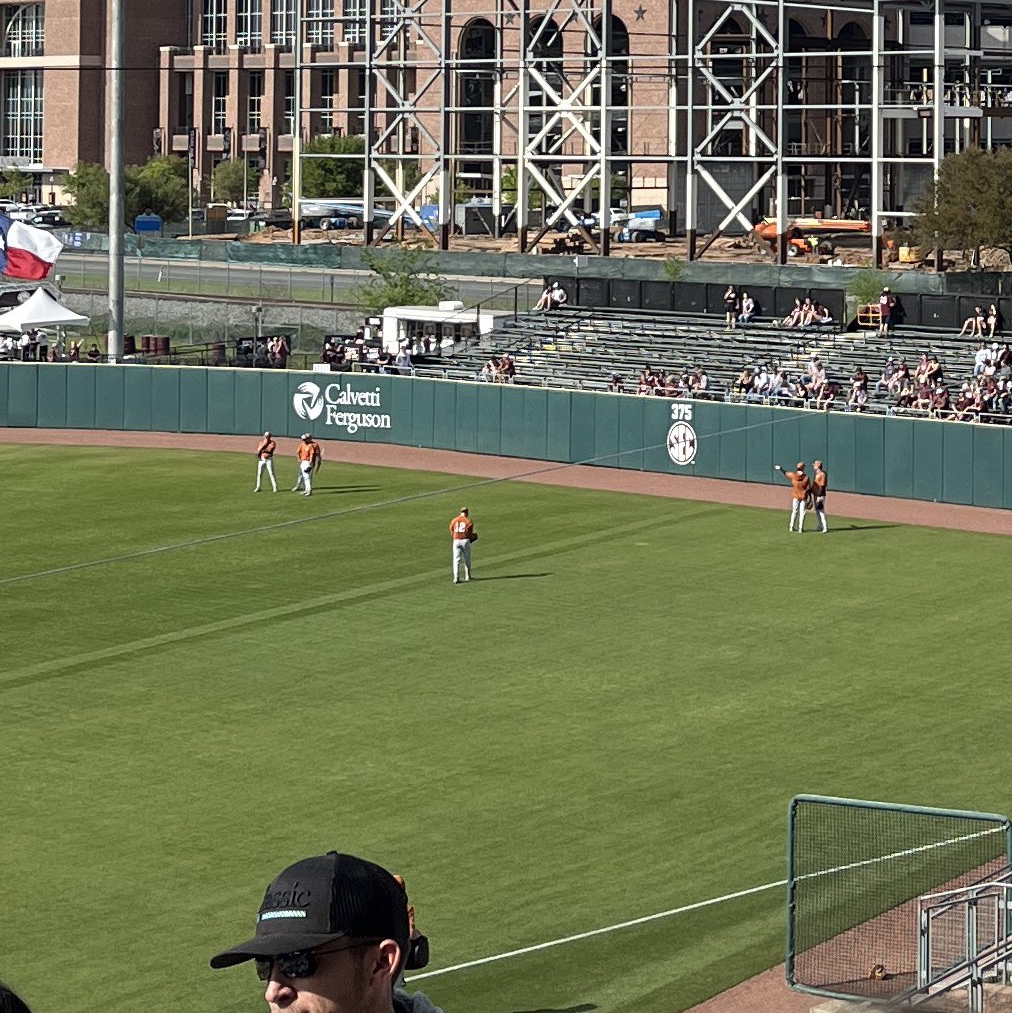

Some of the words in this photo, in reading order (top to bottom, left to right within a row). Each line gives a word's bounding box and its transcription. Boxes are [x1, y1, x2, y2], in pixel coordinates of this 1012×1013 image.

[325, 383, 380, 406] Calvetti
[326, 405, 391, 433] Ferguson
[671, 404, 692, 420] 375
